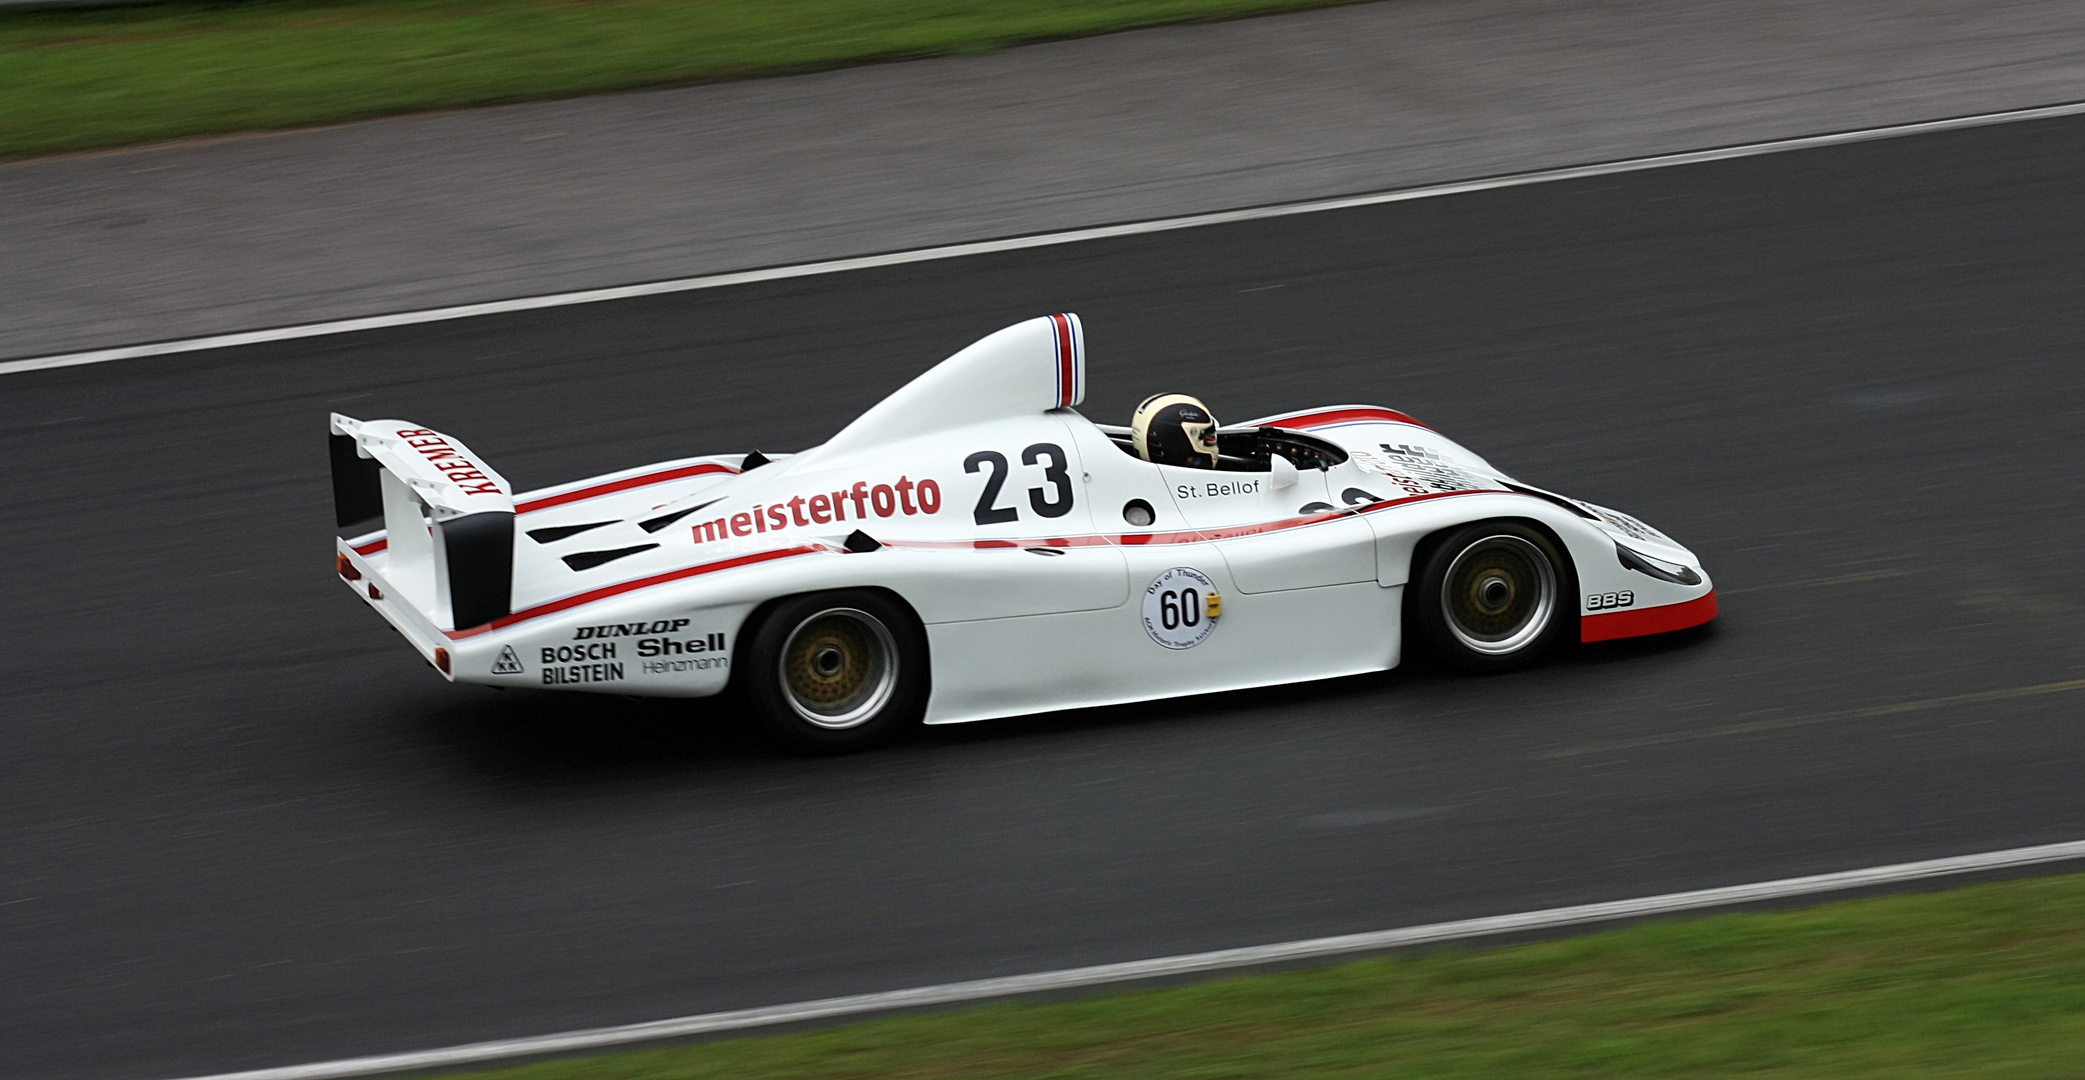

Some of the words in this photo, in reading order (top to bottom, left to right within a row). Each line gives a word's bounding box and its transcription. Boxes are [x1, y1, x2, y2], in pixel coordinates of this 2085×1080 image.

[396, 427, 504, 495] KREMER
[963, 442, 1074, 526] 23
[1177, 484, 1202, 499] St.
[1206, 480, 1259, 497] Bellof
[691, 475, 942, 544] meisterfoto
[1146, 579, 1163, 595] Day
[1164, 571, 1173, 581] of
[1176, 569, 1209, 586] Thunder
[1160, 587, 1201, 630] 60
[1586, 590, 1634, 611] BBS
[572, 618, 690, 640] DUNLOP
[541, 642, 616, 664] BOSCH
[637, 633, 726, 658] Shell
[542, 662, 624, 685] BILSTEIN
[642, 657, 728, 675] Heinzmann
